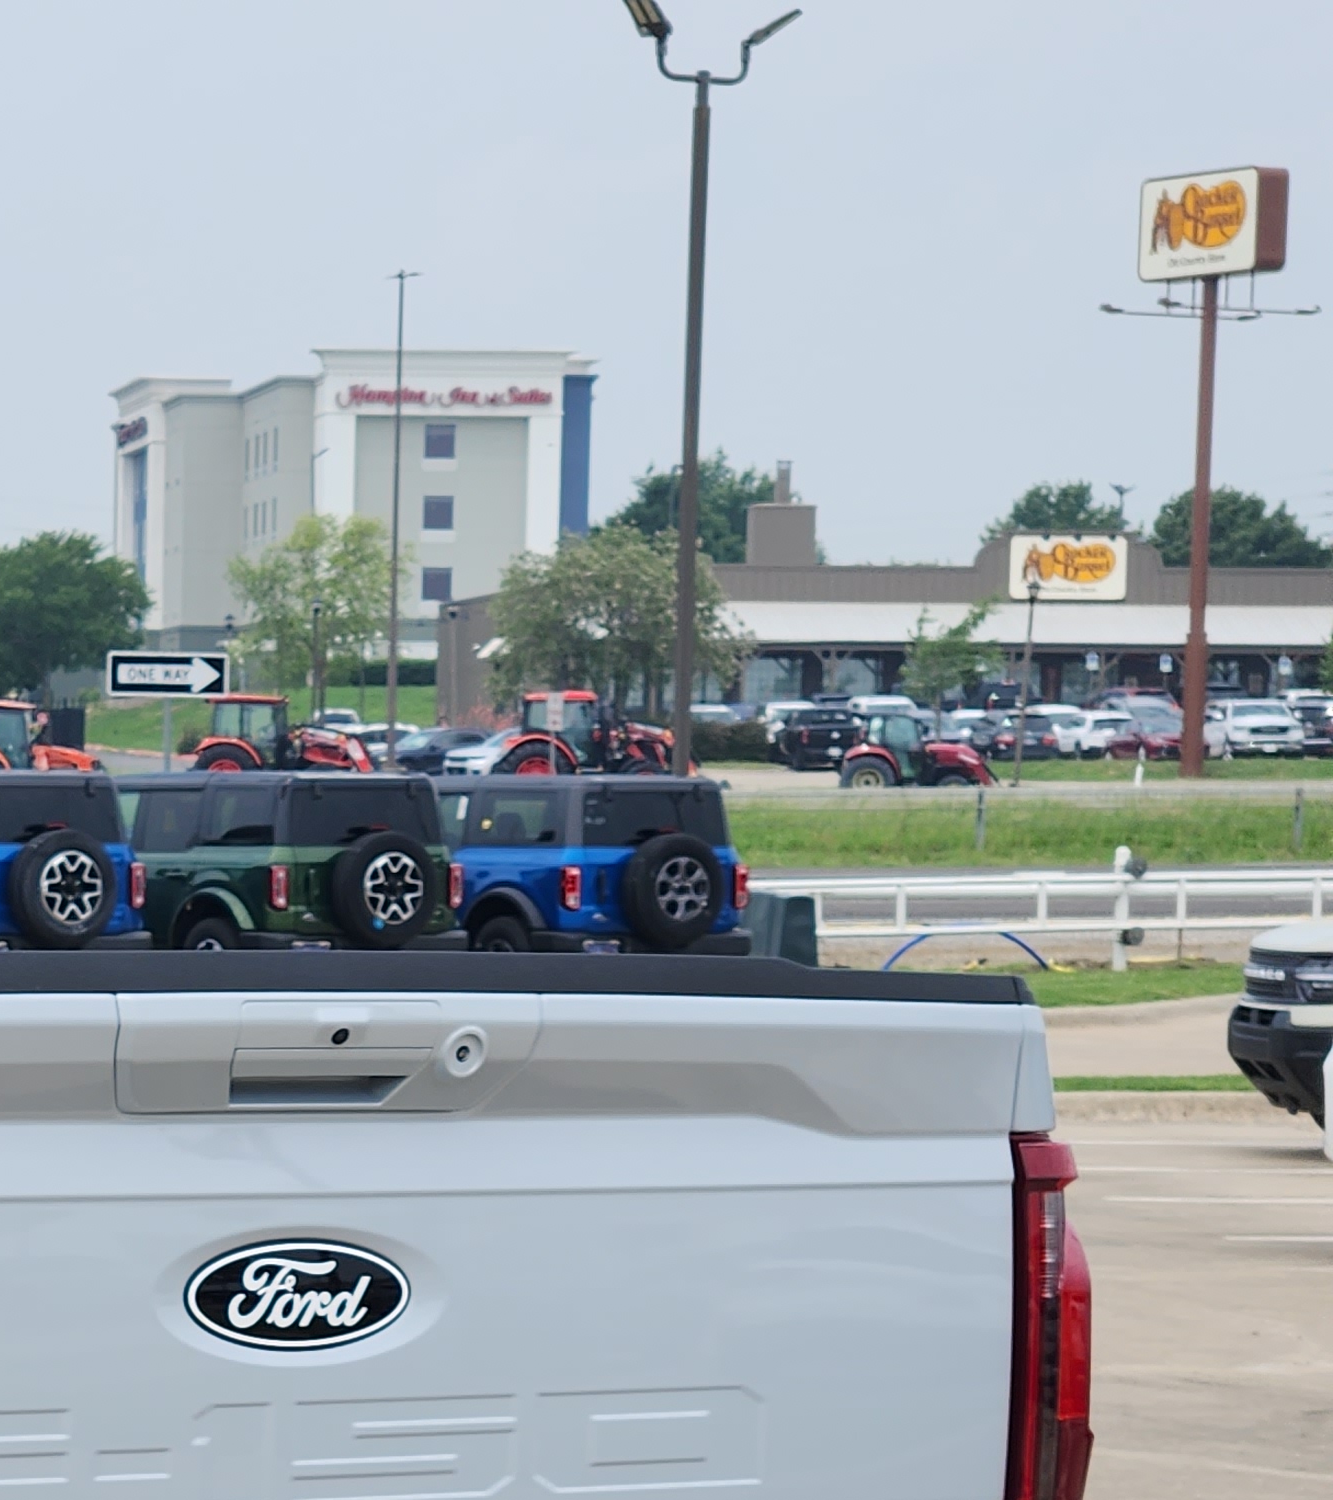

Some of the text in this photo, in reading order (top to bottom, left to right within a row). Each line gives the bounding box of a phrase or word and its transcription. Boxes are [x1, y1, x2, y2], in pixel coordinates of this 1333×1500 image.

[127, 668, 191, 681] ONE WAY
[228, 1257, 372, 1328] Ford
